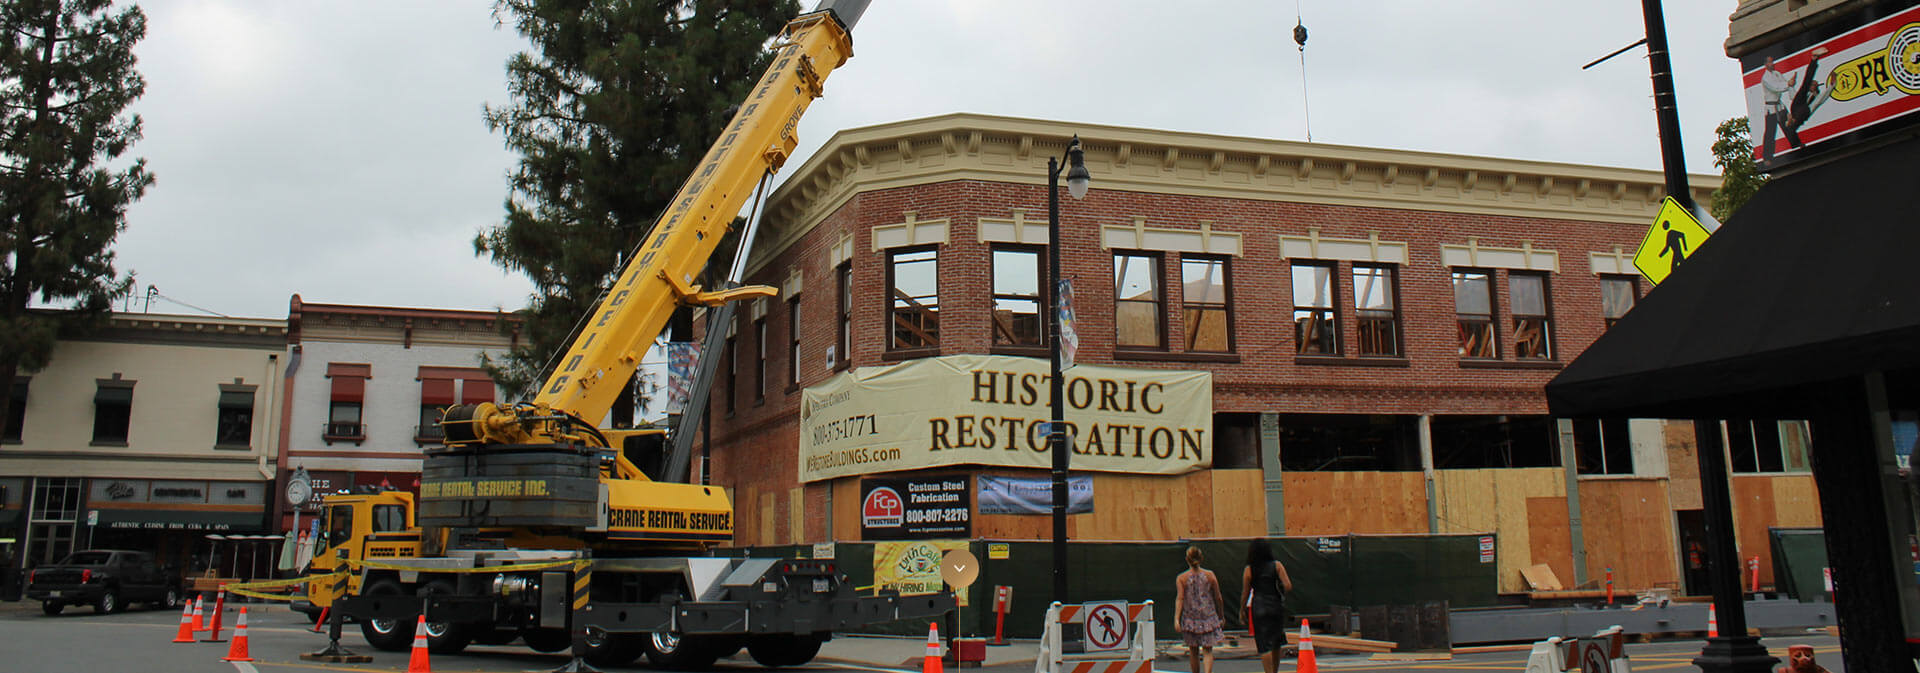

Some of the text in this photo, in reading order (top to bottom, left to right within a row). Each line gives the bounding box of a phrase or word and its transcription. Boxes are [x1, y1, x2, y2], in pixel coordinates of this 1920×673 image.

[1857, 55, 1890, 92] PA
[780, 104, 804, 141] GROVE
[688, 103, 759, 194] RENTAL
[596, 197, 694, 326] SERVICE
[549, 332, 597, 394] INC
[813, 414, 879, 447] 800-375-1771
[442, 481, 475, 497] RENTAL
[476, 480, 522, 497] SERVICE
[525, 480, 550, 496] INC.
[908, 480, 965, 492] Custom Steel
[911, 492, 959, 503] Fabrication
[873, 492, 898, 517] FCP
[906, 508, 968, 523] 800-807-2276
[608, 508, 645, 528] CRANE
[648, 510, 687, 529] RENTAL
[900, 582, 924, 593] HIRING
